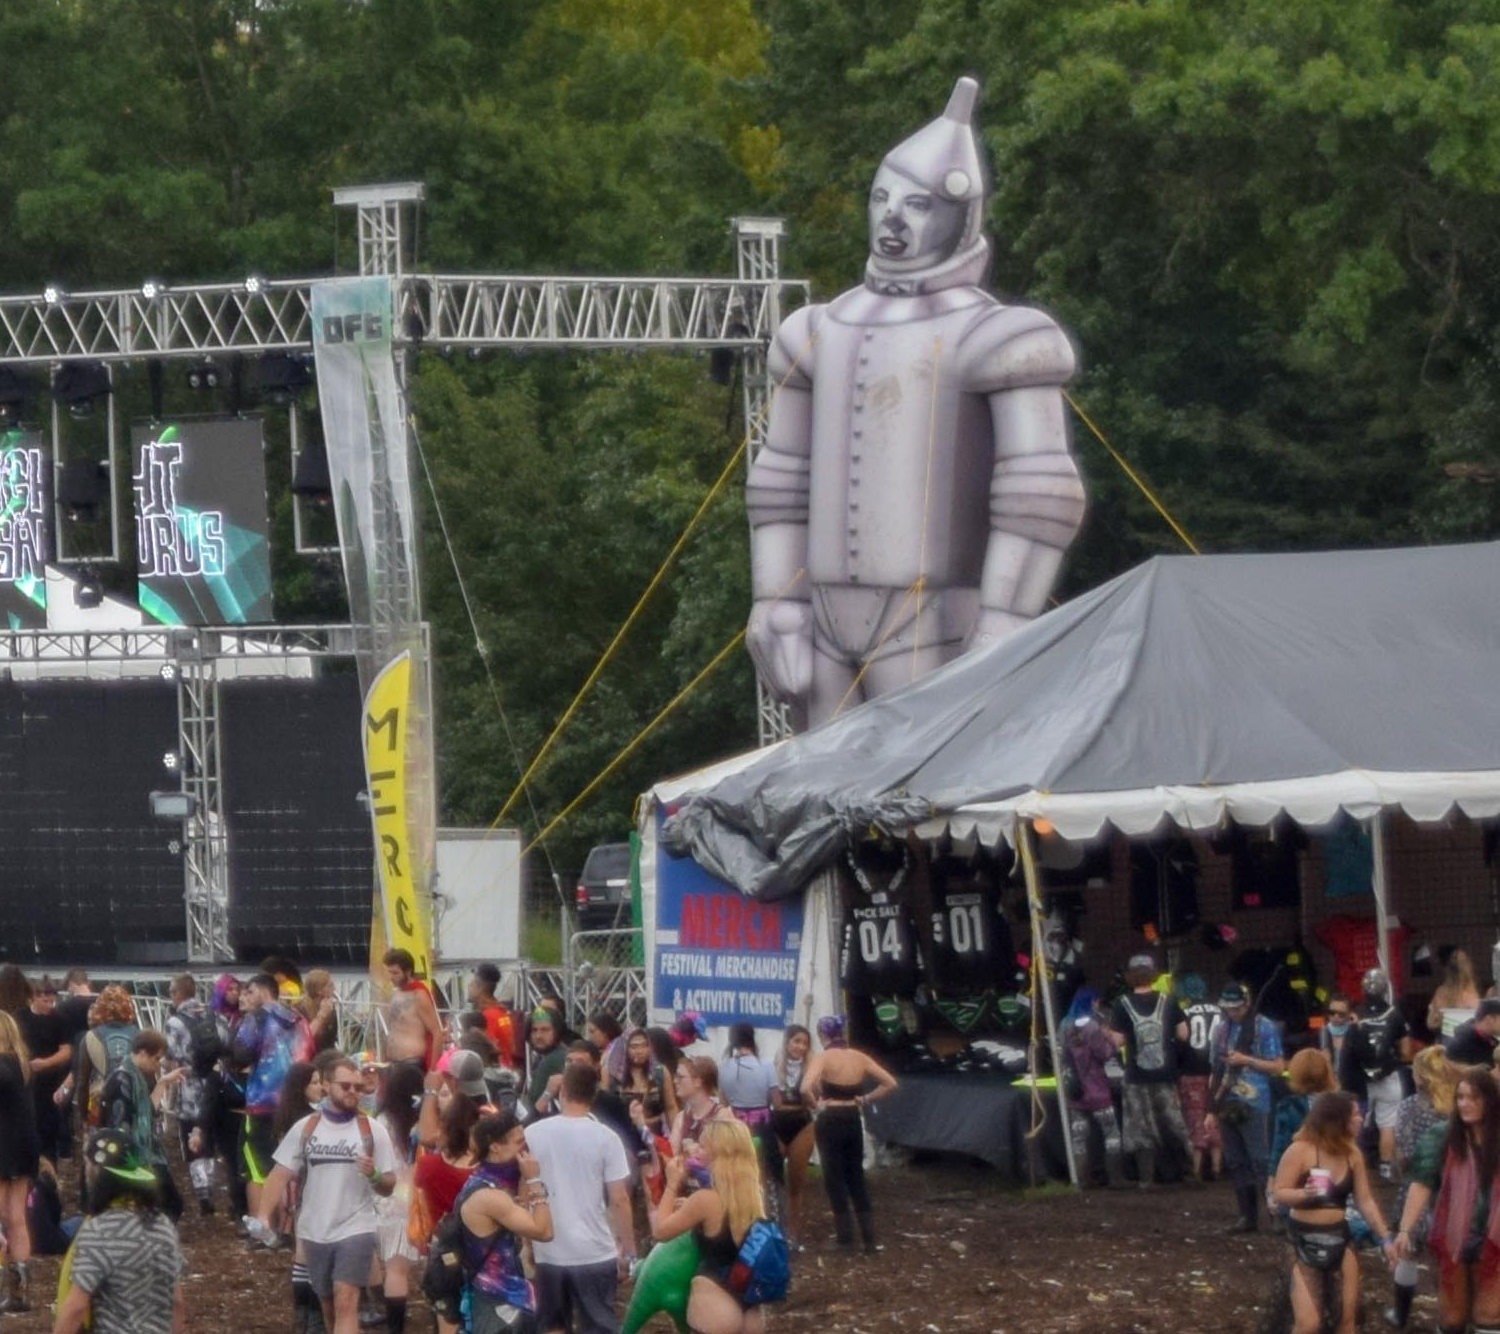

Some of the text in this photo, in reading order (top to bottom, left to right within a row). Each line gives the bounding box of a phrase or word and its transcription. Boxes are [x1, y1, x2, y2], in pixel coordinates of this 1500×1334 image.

[679, 893, 782, 952] MERCH
[858, 918, 903, 963] 04
[949, 906, 985, 954] 01
[660, 952, 795, 981] FESTIVAL MERCHANDISE
[672, 988, 782, 1016] & ACTIVITY TICKETS
[306, 1136, 359, 1157] Sandlot
